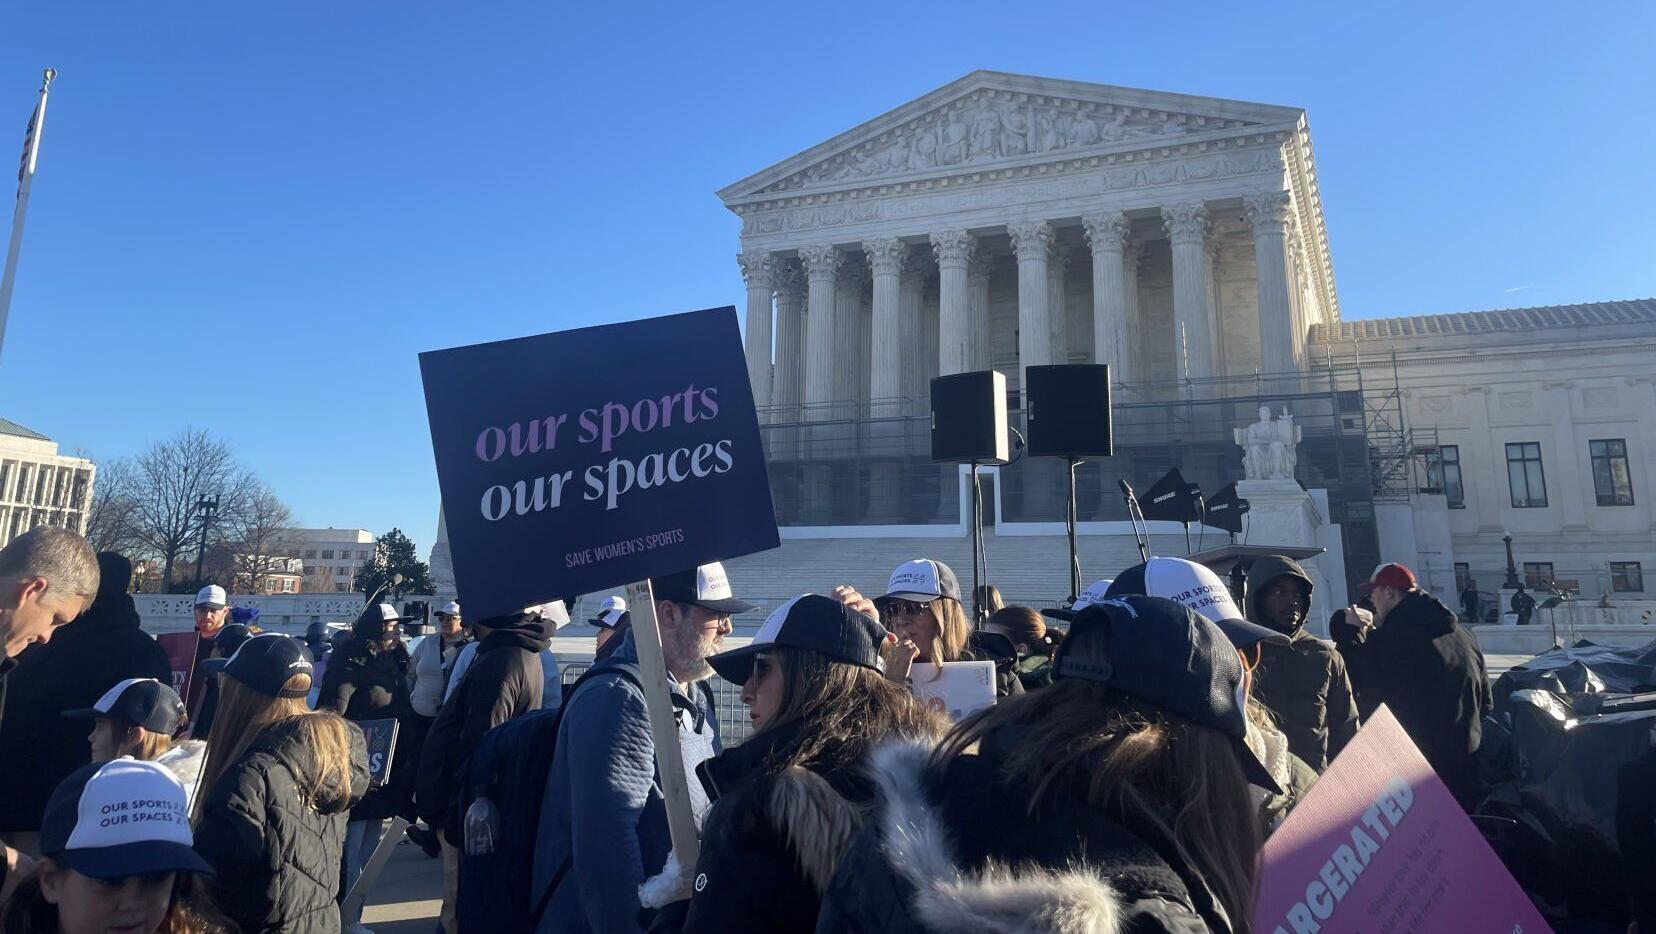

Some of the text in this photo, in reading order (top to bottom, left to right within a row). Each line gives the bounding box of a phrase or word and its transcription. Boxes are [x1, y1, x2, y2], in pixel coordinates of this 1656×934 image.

[475, 384, 719, 462] our sports
[481, 439, 733, 521] our spaces
[1153, 491, 1176, 504] SHURE
[565, 528, 684, 568] SAVE WOMEN'S SPORTS
[100, 813, 174, 827] OUR SPACES
[102, 800, 173, 815] OUR SPORTS
